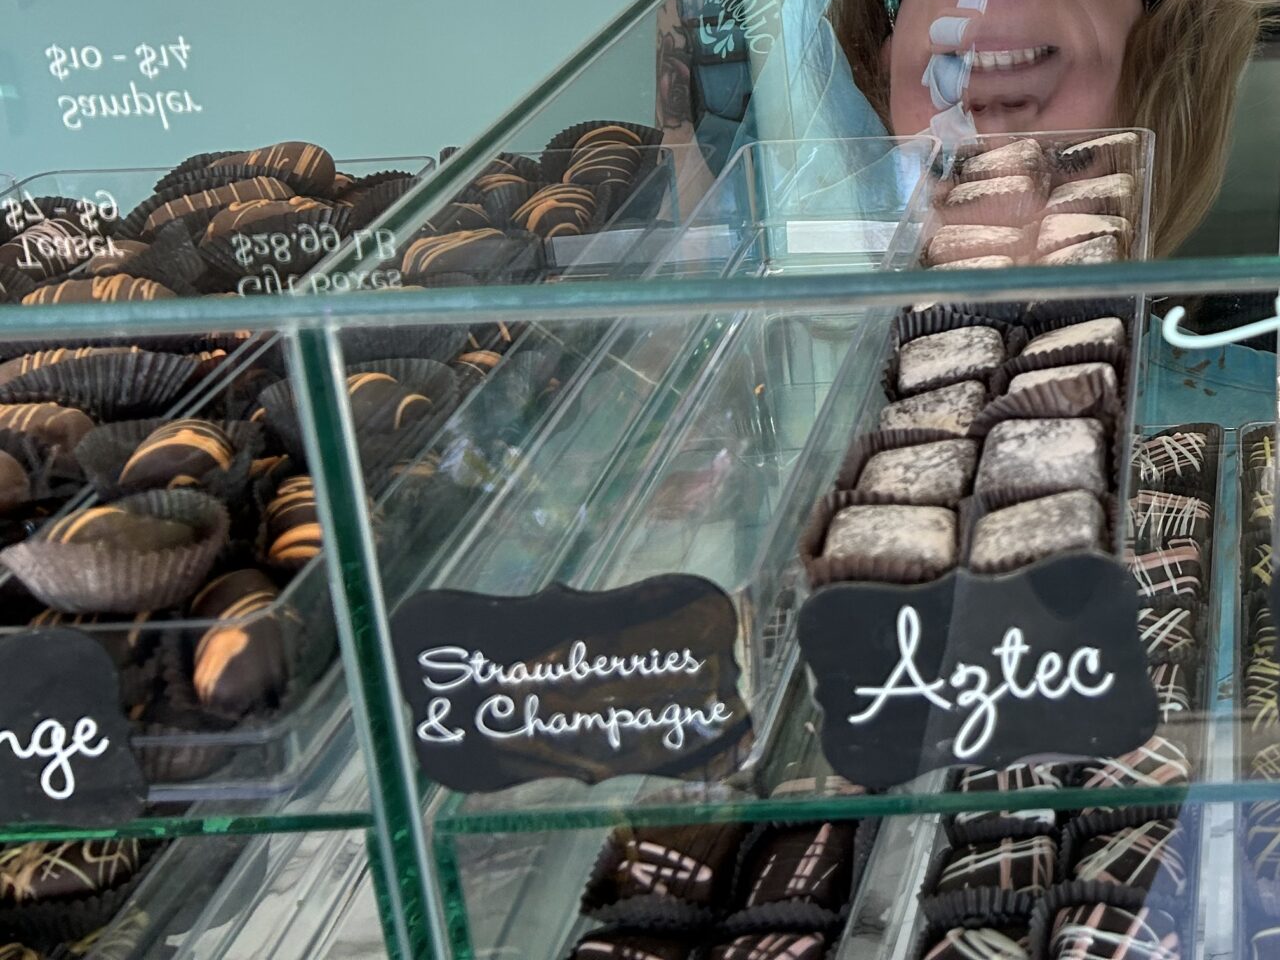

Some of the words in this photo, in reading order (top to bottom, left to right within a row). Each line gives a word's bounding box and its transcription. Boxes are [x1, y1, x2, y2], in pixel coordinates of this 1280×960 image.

[416, 640, 707, 691] Strawberries
[847, 604, 1116, 760] Aztec
[416, 697, 467, 744] &
[474, 693, 734, 750] Champagne
